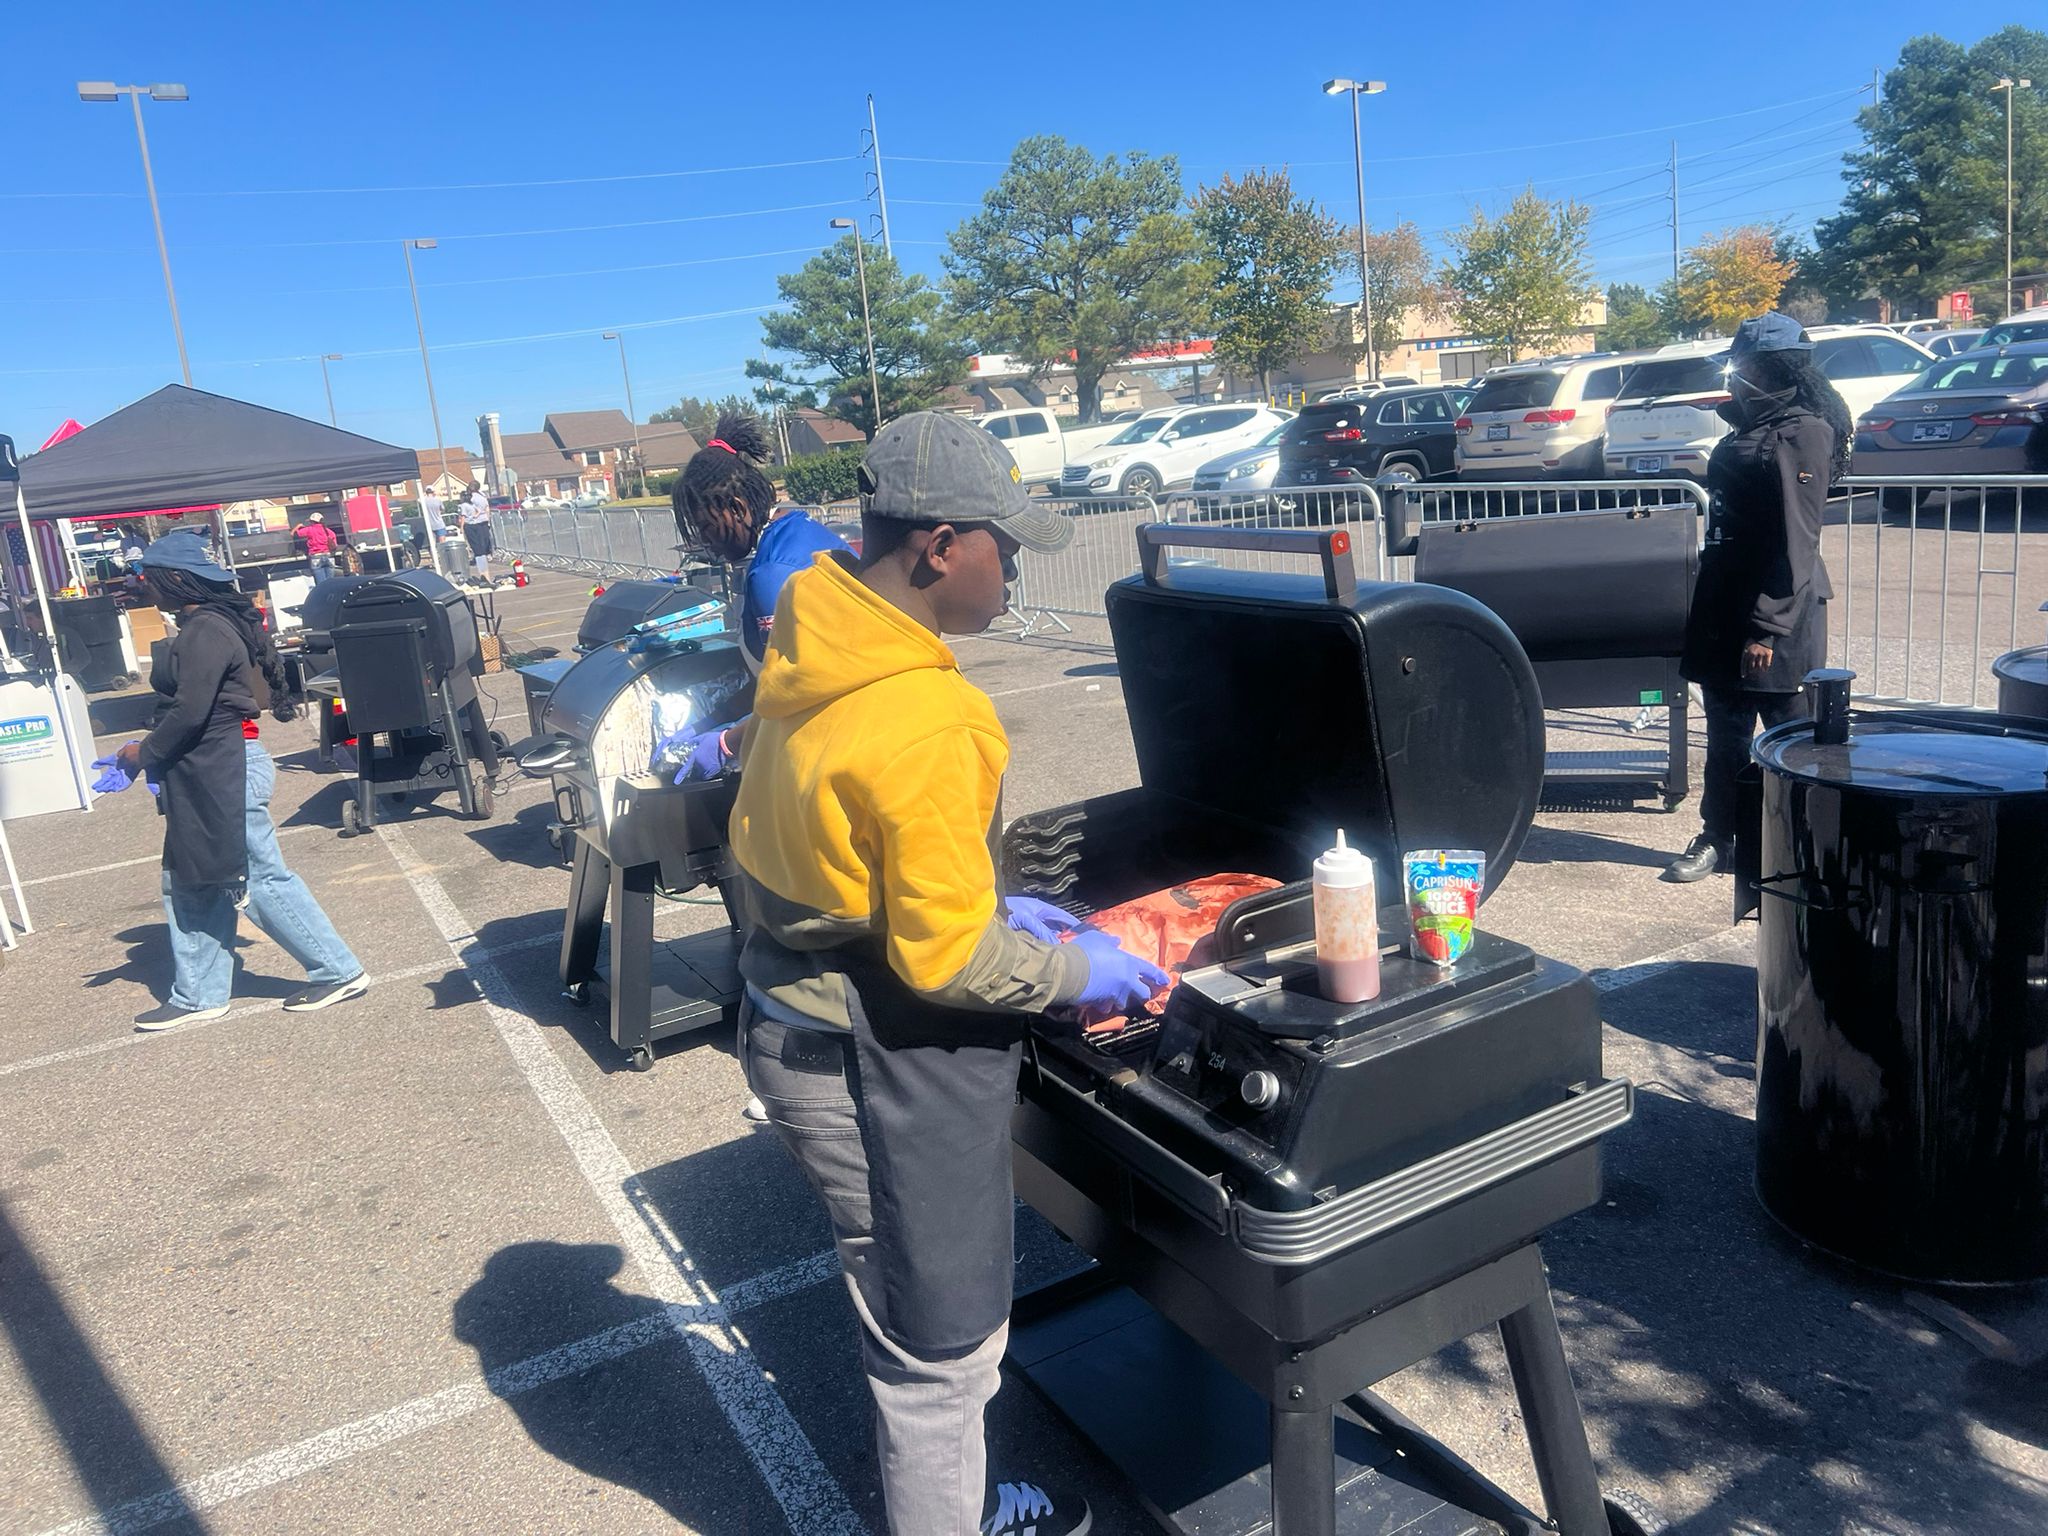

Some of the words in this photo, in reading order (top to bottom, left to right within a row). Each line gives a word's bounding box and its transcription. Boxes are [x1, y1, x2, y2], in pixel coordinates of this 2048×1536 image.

[0, 723, 23, 737] ASTE
[25, 720, 46, 733] PRO
[1427, 891, 1464, 901] 100%
[1421, 901, 1467, 915] JUICE
[1208, 1051, 1226, 1072] 254
